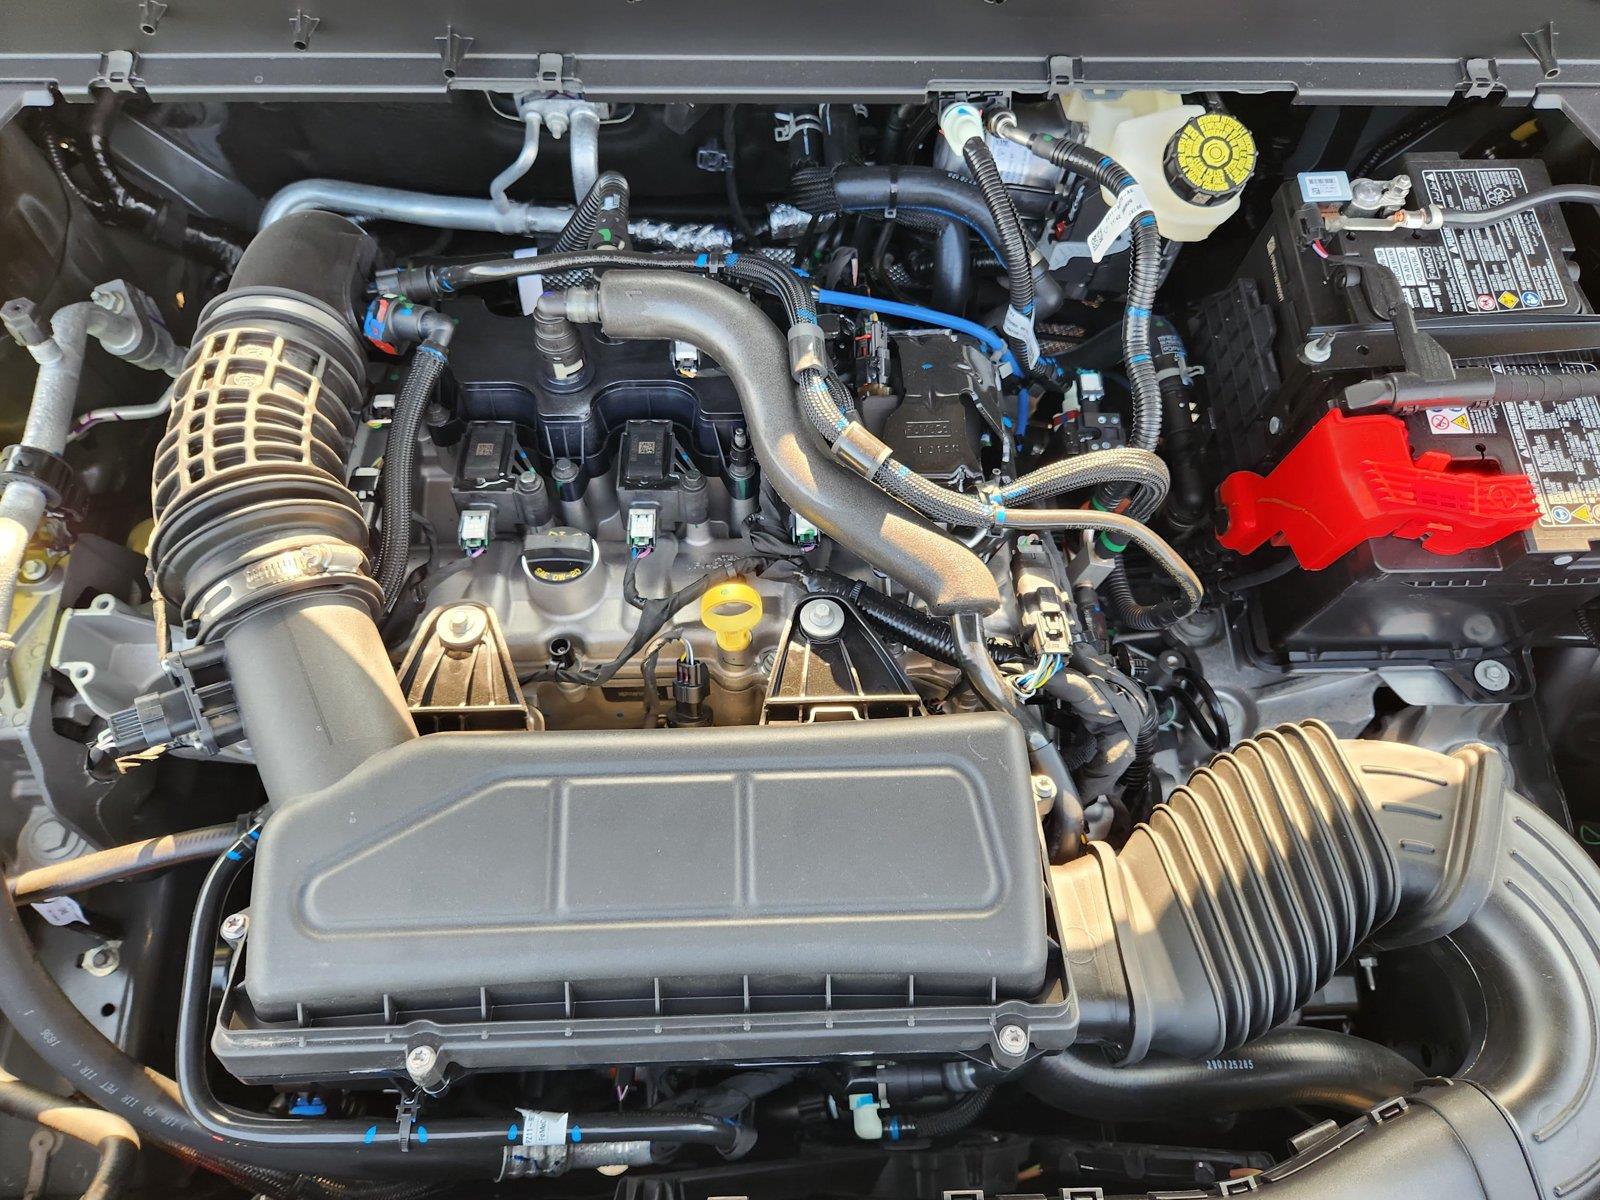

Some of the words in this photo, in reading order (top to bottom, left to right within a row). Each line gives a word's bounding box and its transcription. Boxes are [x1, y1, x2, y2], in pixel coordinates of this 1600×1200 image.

[1421, 248, 1437, 277] FoMoCo
[1429, 281, 1441, 295] MF
[534, 567, 550, 580] SAE
